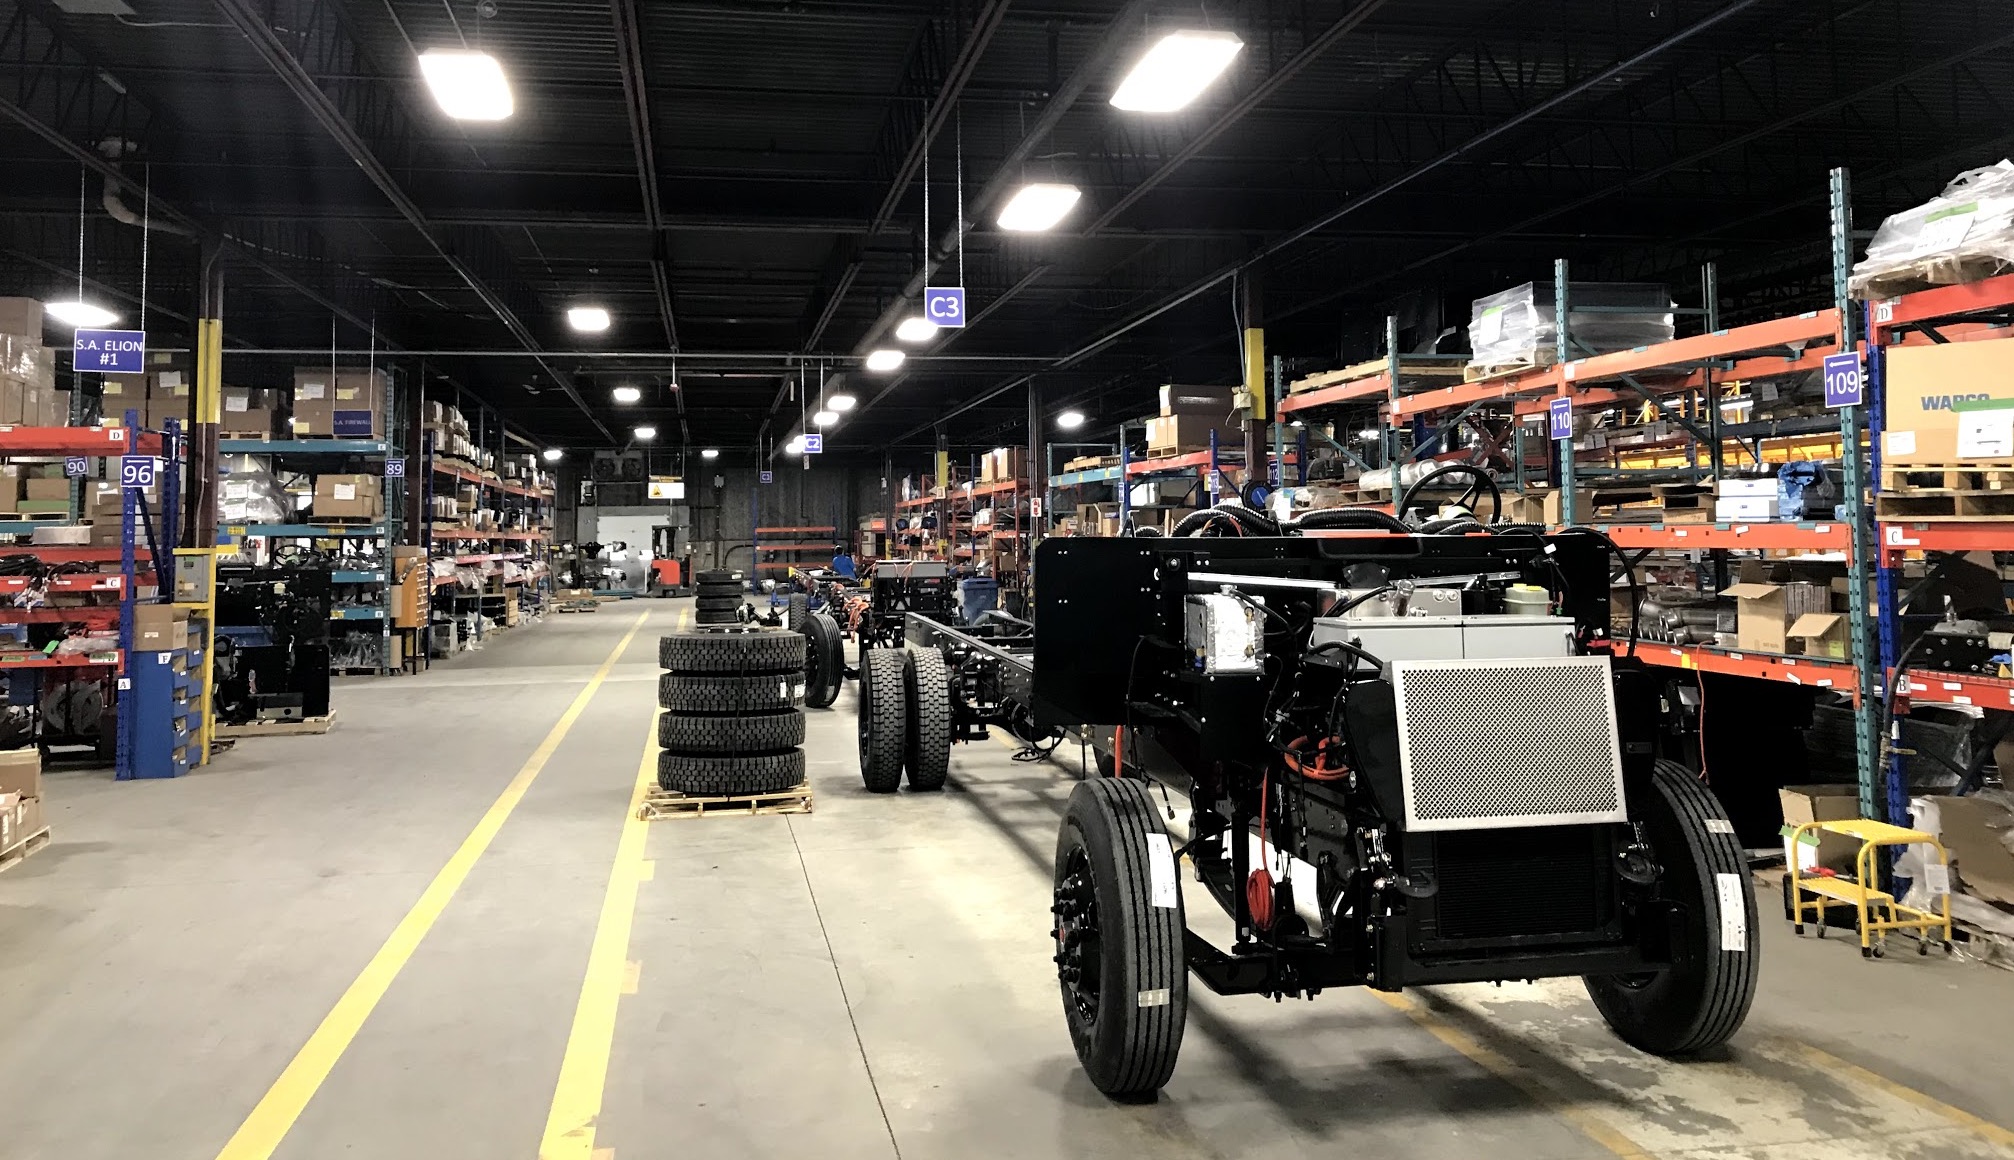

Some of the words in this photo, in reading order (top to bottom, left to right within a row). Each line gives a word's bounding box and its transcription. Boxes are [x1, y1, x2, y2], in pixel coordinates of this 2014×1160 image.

[930, 296, 960, 317] C3
[1881, 307, 1888, 319] D
[76, 339, 100, 350] S.A.
[104, 341, 142, 351] ELION
[100, 353, 118, 365] #1
[1827, 370, 1858, 395] 109
[1552, 411, 1570, 430] 110
[806, 438, 820, 449] C2
[68, 461, 85, 473] 90
[386, 464, 402, 475] 89
[123, 465, 151, 483] 96
[1891, 531, 1898, 543] C
[1900, 680, 1906, 691] B
